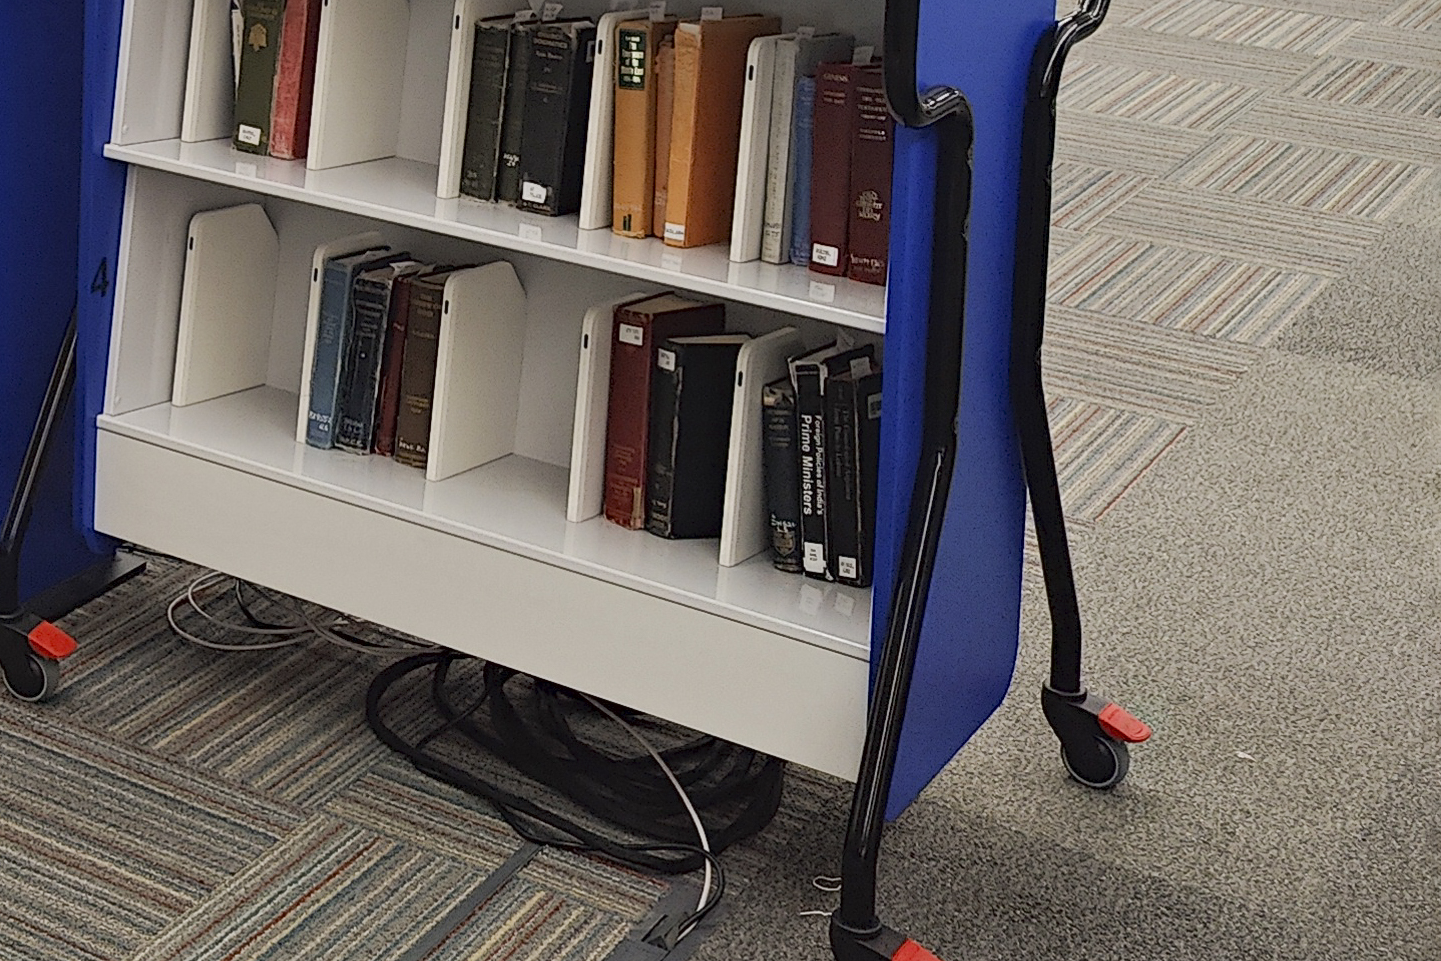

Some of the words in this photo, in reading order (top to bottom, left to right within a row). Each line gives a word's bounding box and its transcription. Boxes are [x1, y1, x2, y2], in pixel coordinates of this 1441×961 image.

[90, 257, 109, 297] 4
[801, 414, 813, 452] Prime
[814, 414, 823, 446] Foreign
[815, 447, 824, 478] Policies
[802, 455, 814, 516] Ministers
[816, 479, 824, 488] of
[816, 488, 825, 516] India's
